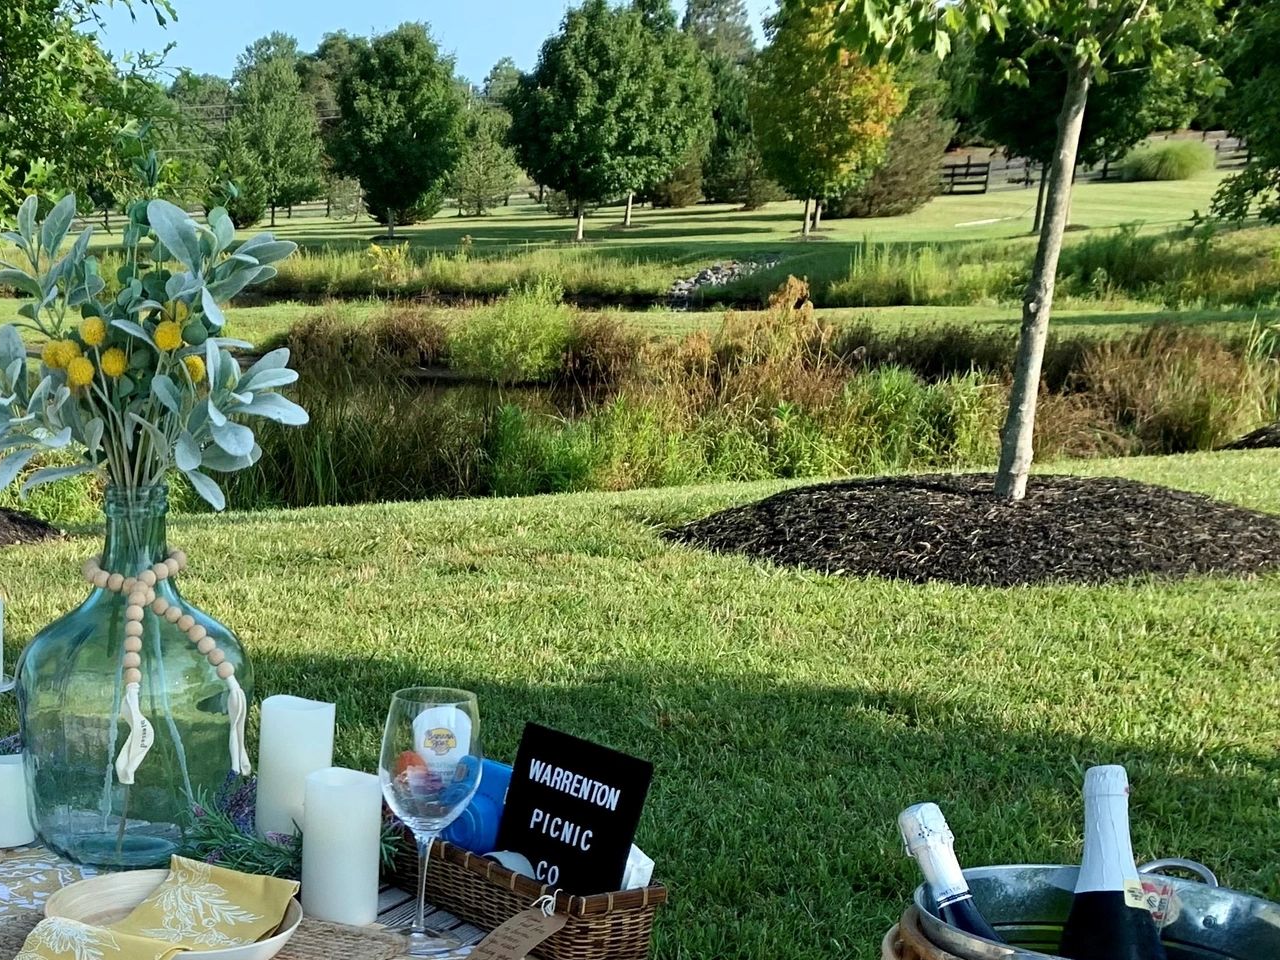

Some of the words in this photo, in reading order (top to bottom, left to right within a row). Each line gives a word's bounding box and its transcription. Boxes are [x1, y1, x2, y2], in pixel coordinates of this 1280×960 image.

[528, 758, 621, 811] WARRENTON
[529, 808, 593, 851] PICNIC
[536, 860, 560, 886] CO
